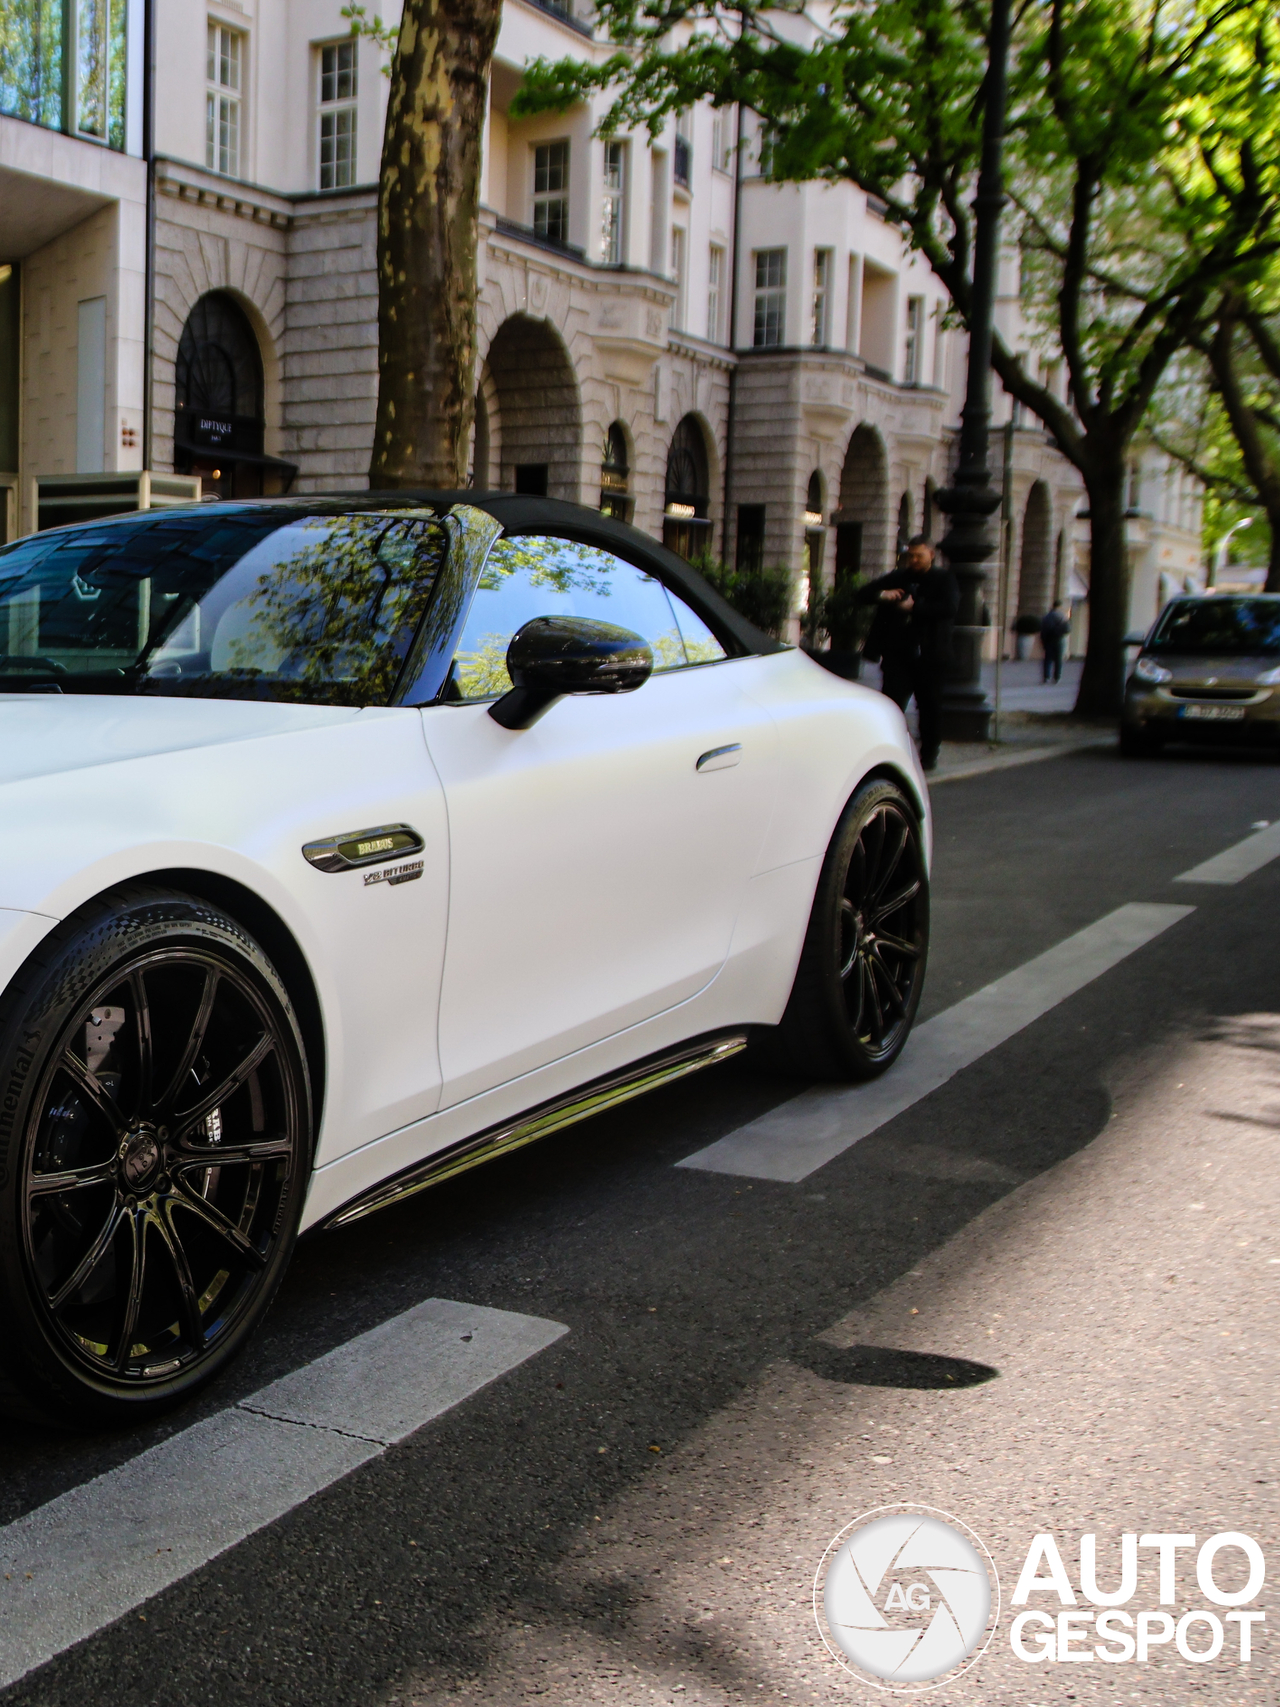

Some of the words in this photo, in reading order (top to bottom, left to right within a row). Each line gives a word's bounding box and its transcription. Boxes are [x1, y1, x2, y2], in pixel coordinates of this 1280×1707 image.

[200, 419, 231, 433] DIPTYQUE
[358, 838, 393, 855] BRABUS
[383, 860, 424, 877] BITURBO
